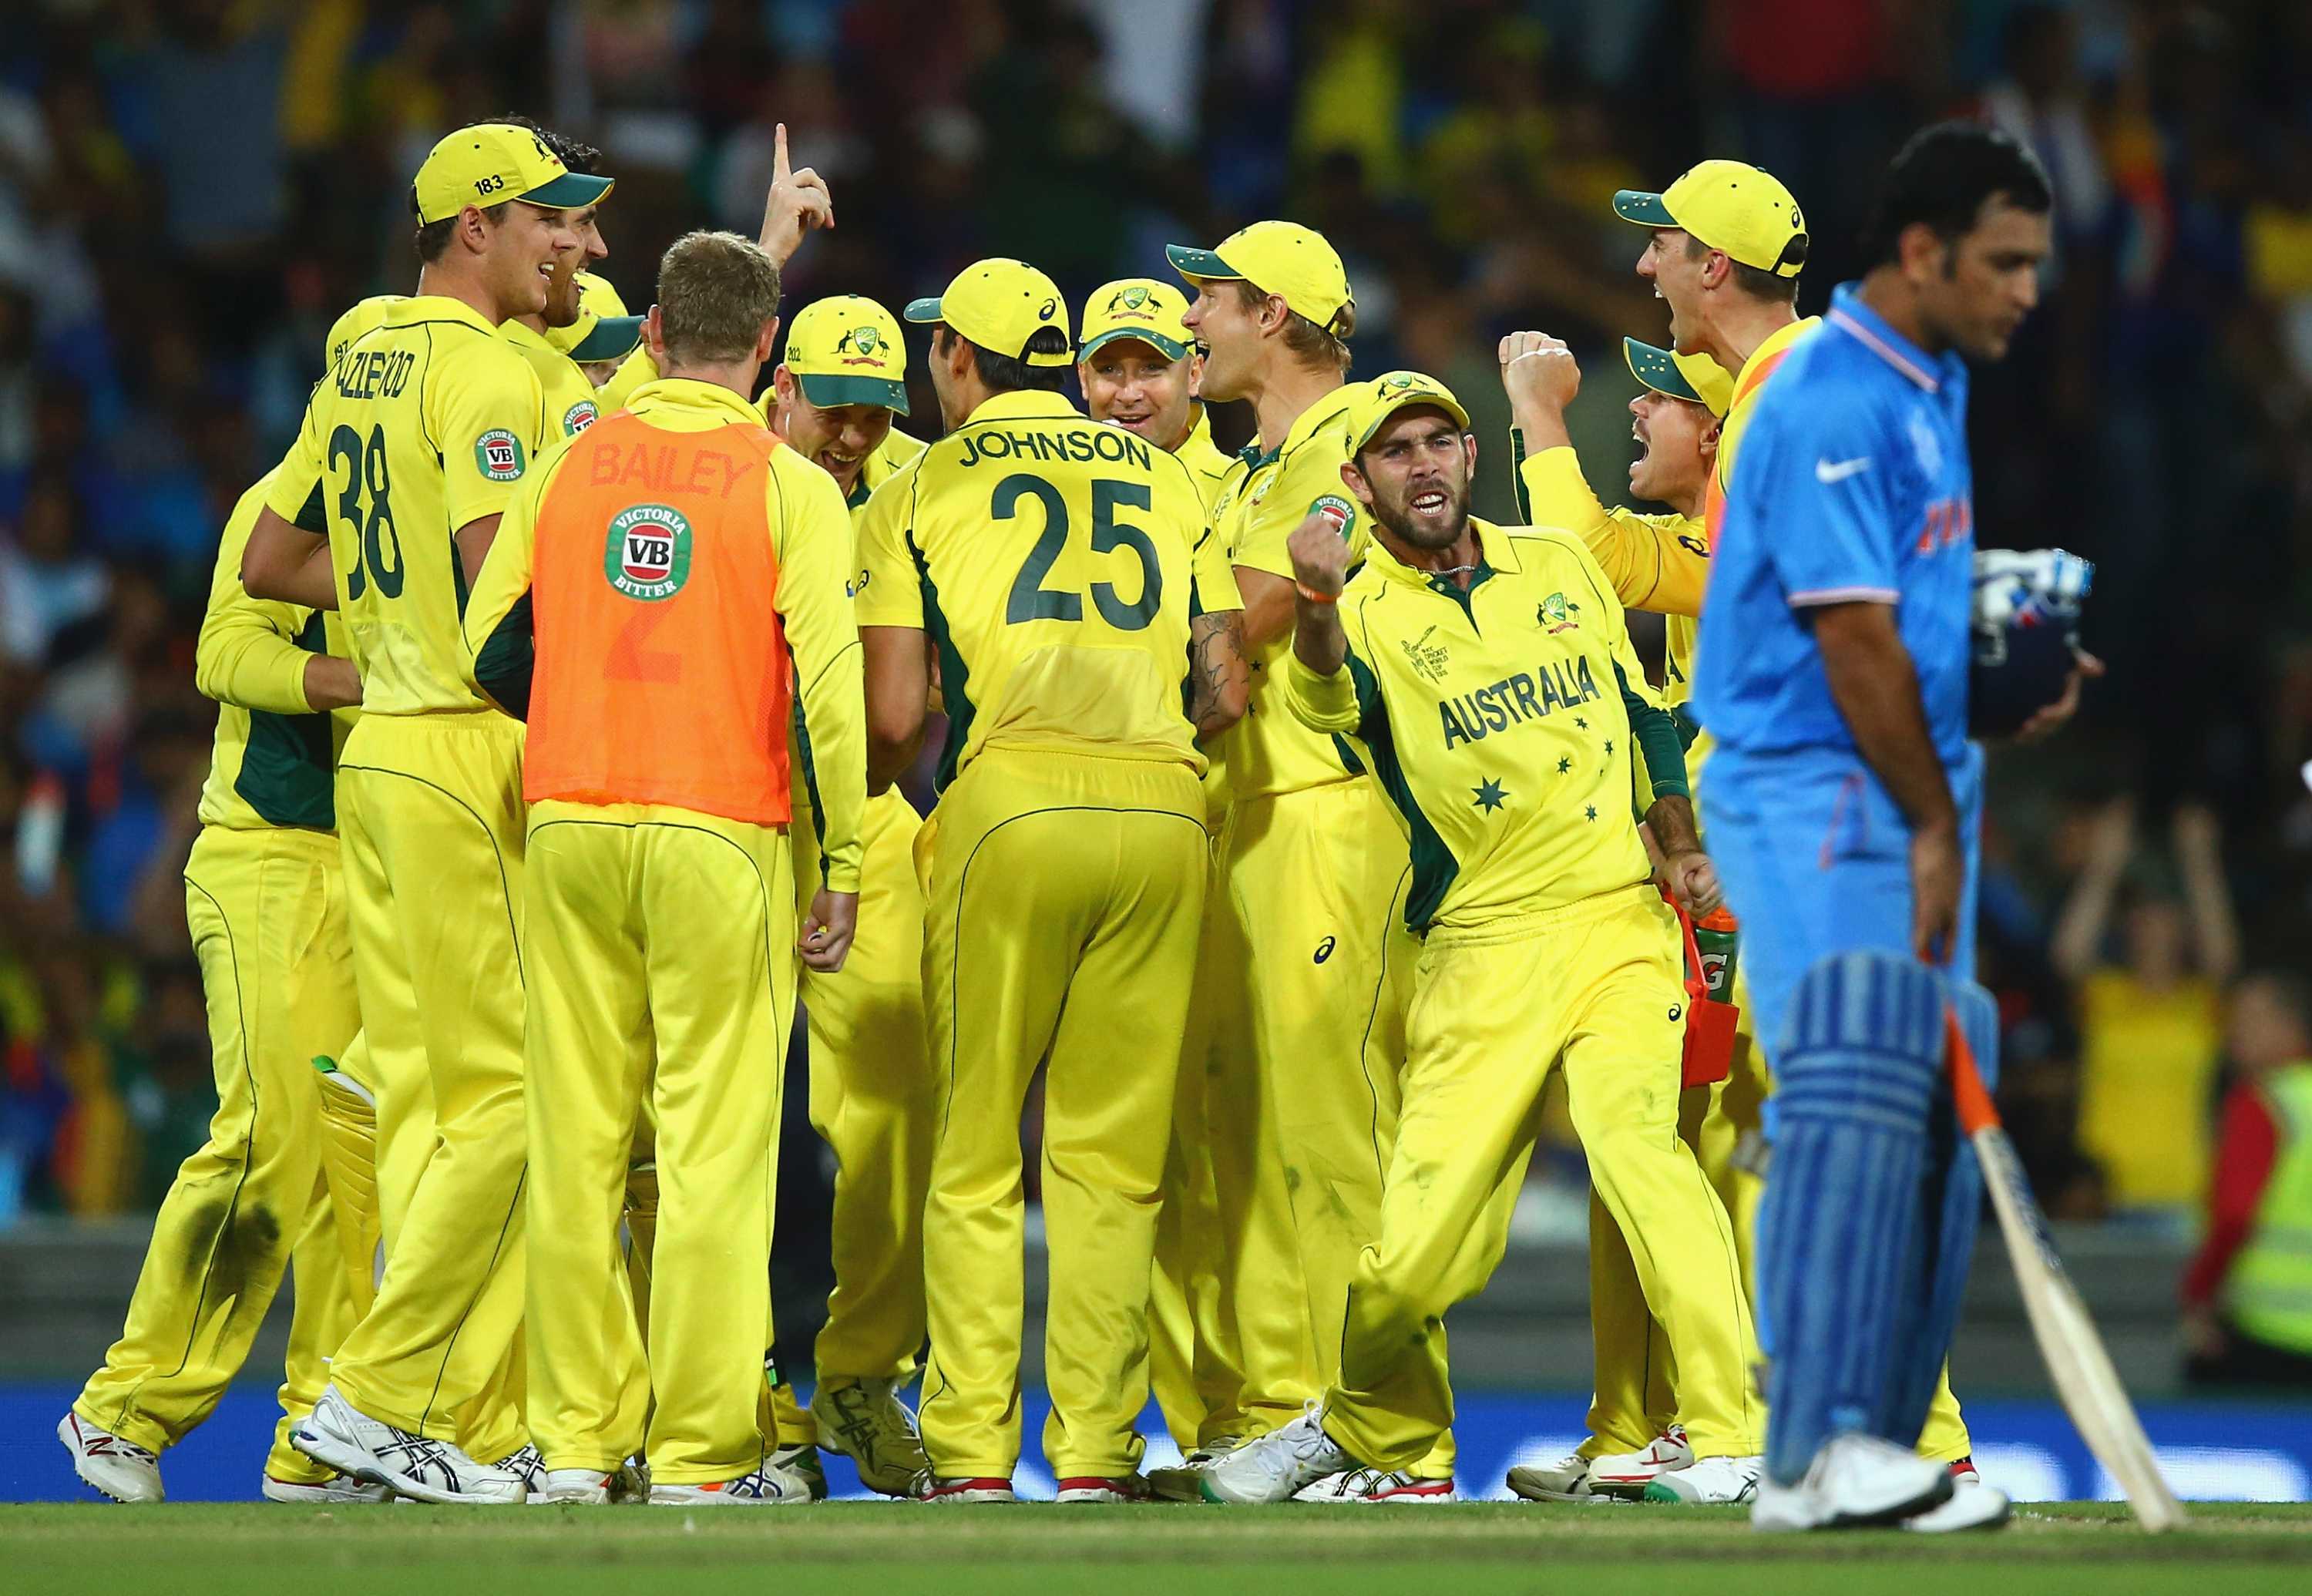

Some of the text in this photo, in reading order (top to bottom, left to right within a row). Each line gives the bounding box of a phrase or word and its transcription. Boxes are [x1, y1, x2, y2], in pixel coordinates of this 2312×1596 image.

[474, 174, 504, 196] 183
[565, 402, 596, 425] VICTORIA
[477, 430, 516, 447] VICTORIA
[959, 431, 1152, 472] JOHNSON
[488, 449, 513, 462] VB
[487, 469, 522, 479] BITTER
[590, 442, 755, 499] BAILEY
[328, 423, 405, 601] 38
[615, 507, 685, 536] VICTORIA
[1316, 496, 1354, 519] VICTORIA
[627, 538, 670, 566] VB
[991, 473, 1163, 631] 25
[615, 576, 677, 597] BITTER
[1439, 655, 1601, 751] AUSTRALIA
[1700, 953, 1728, 990] G
